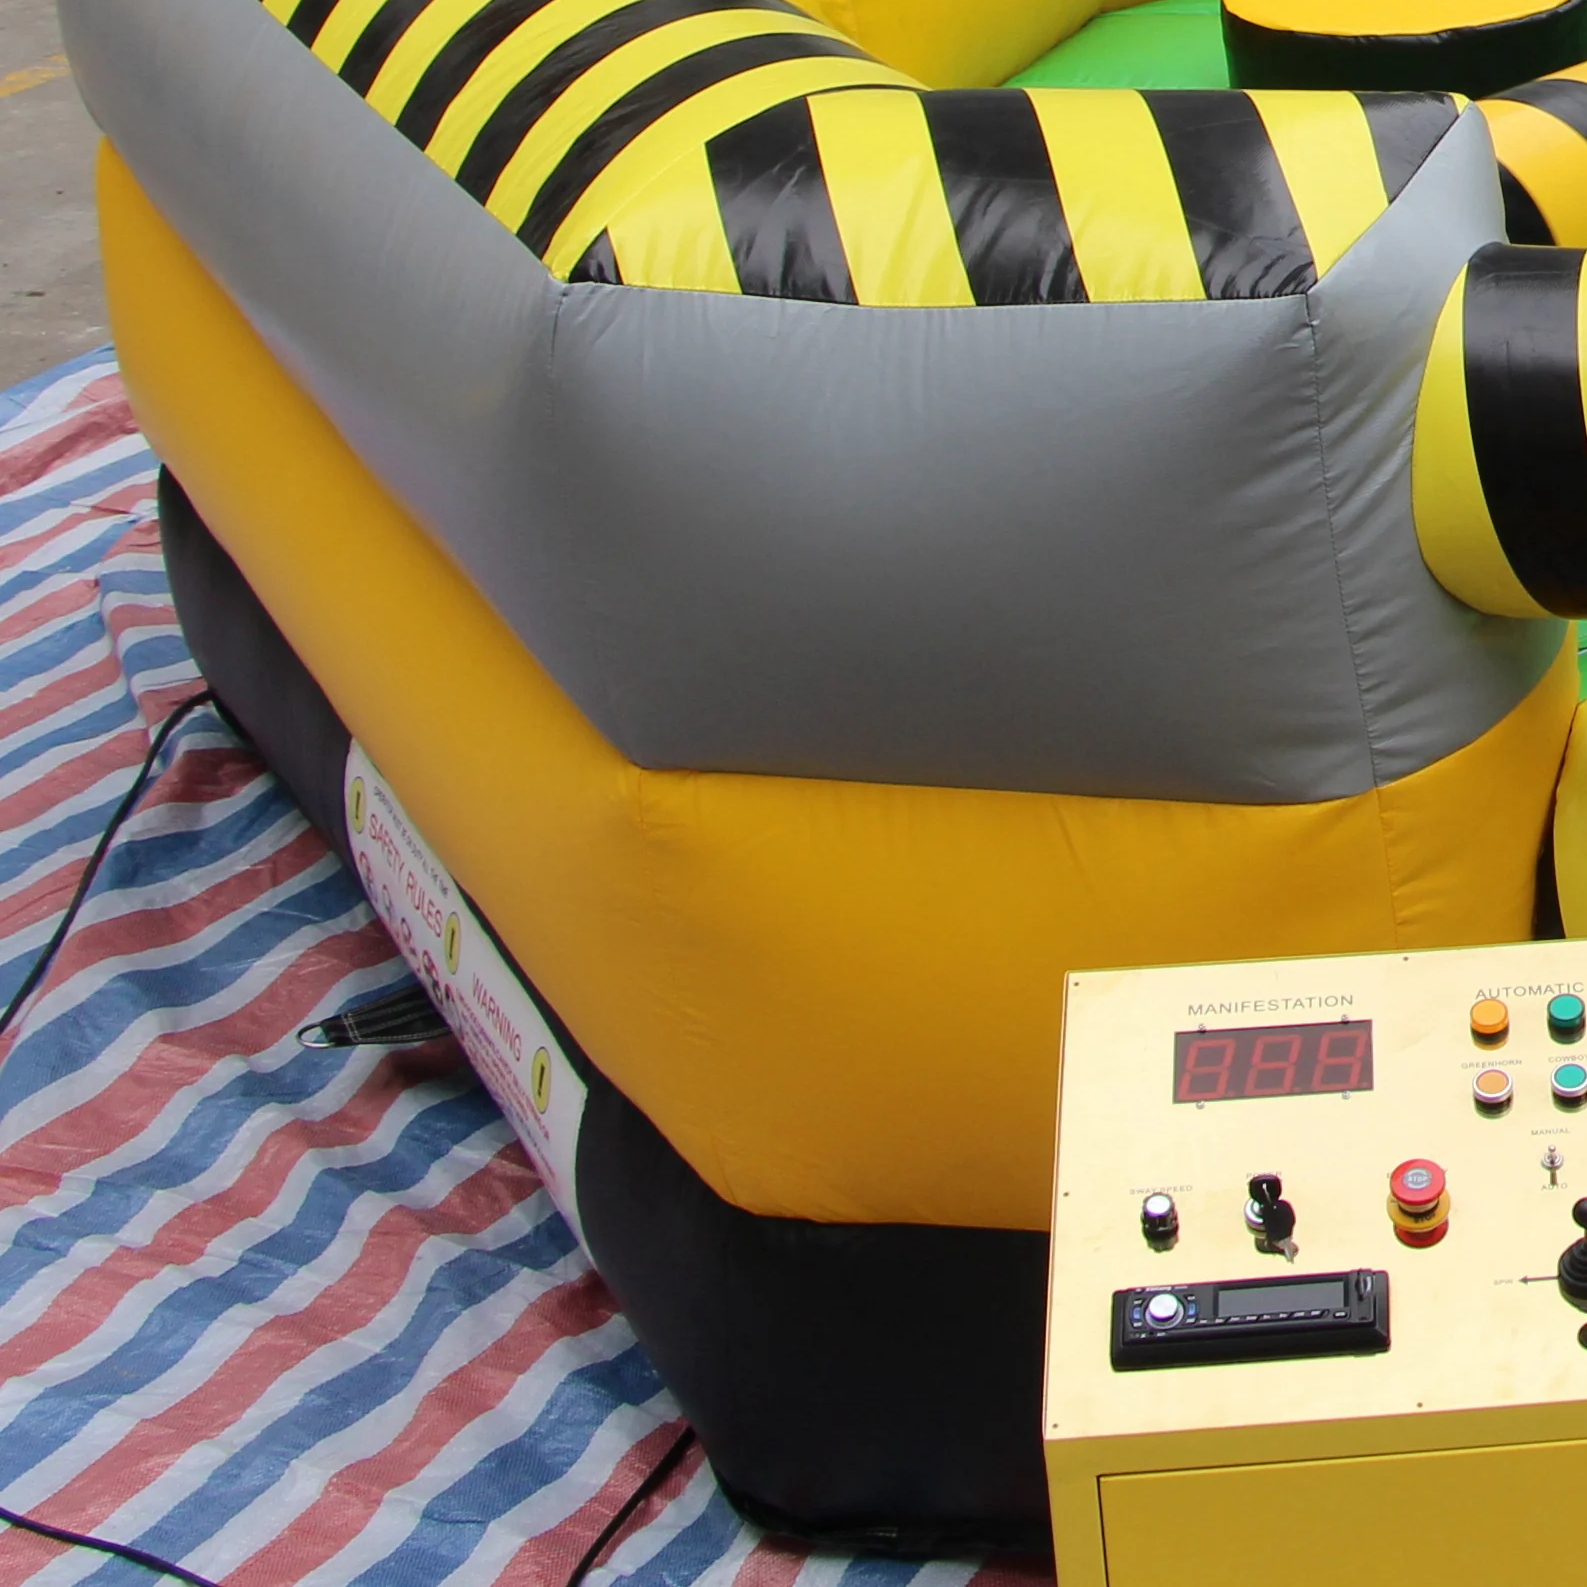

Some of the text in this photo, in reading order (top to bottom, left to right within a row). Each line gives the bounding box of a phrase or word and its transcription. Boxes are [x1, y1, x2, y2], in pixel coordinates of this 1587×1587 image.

[369, 813, 443, 940] SAFETY RULES
[1475, 981, 1585, 1000] AUTOMATIC
[1188, 994, 1355, 1016] MANIFESTATION
[472, 973, 523, 1063] WARNING
[1461, 1058, 1523, 1070] GREENHORN
[1531, 1127, 1571, 1137] MANUAL
[1408, 1174, 1429, 1183] STOP
